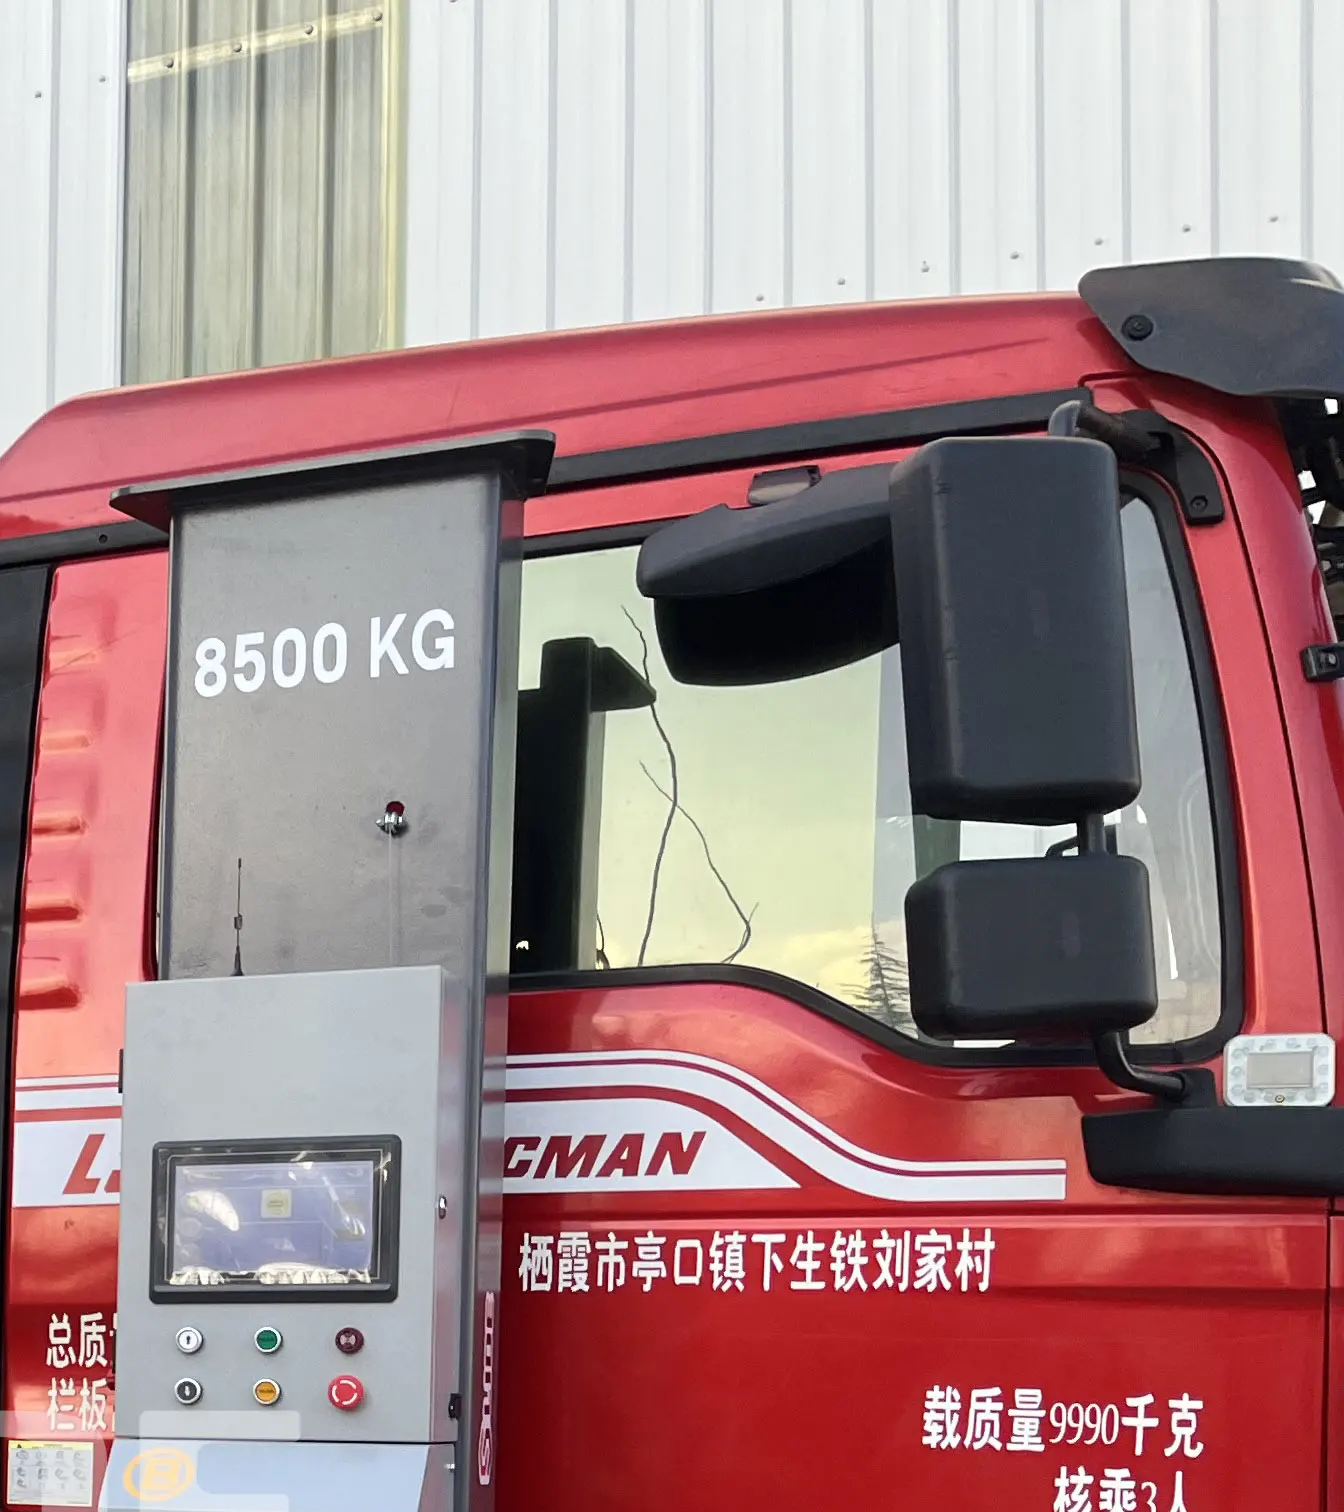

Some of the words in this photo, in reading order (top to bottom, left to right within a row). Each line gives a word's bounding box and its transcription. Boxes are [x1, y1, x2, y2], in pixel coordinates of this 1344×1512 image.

[194, 622, 348, 698] 8500
[369, 608, 455, 678] KG
[518, 1227, 996, 1293] 栖霞市亭口镇下生铁刘家村
[46, 1312, 117, 1368] 总质
[46, 1377, 116, 1432] 栏板
[921, 1385, 1204, 1458] 载质量9990千克
